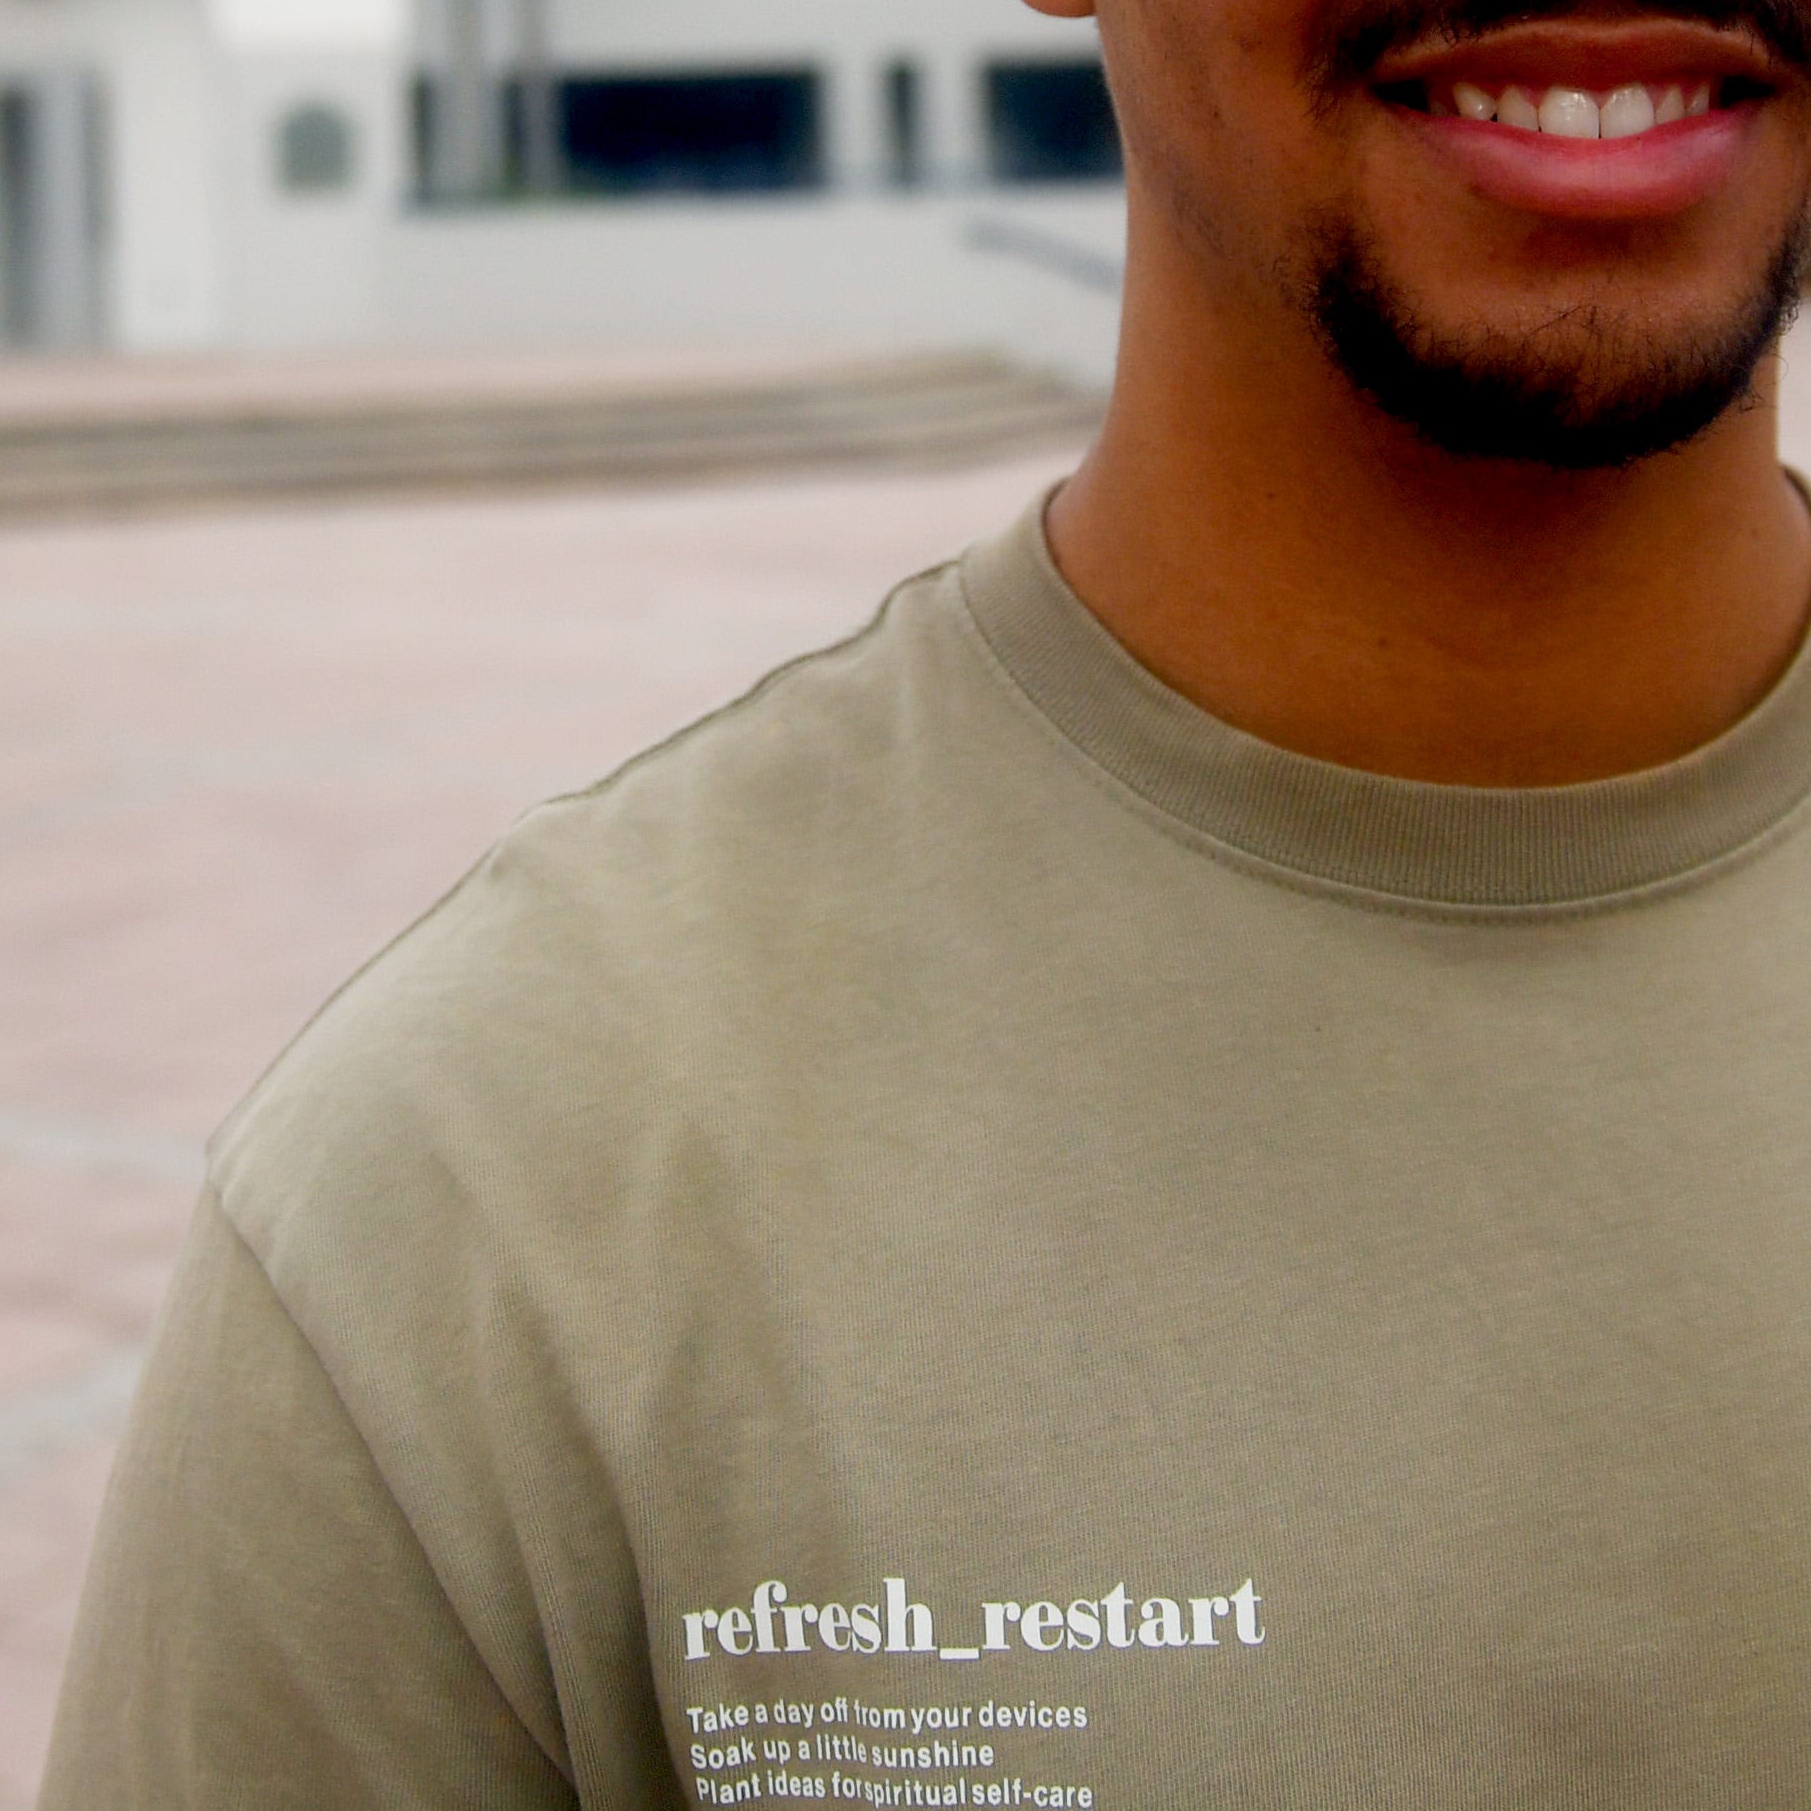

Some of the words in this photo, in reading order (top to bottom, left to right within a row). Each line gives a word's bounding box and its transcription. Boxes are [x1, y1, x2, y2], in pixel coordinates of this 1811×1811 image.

[683, 1578, 1266, 1660] refresh_restart
[686, 1702, 750, 1734] Take
[755, 1702, 769, 1724] a
[773, 1698, 815, 1729] day
[820, 1696, 849, 1723] off
[853, 1699, 906, 1730] from
[910, 1706, 973, 1735] your
[978, 1700, 1088, 1729] devices
[690, 1737, 756, 1770] Soak
[763, 1739, 791, 1765] up
[798, 1739, 811, 1761] a
[816, 1734, 868, 1764] little
[872, 1740, 995, 1769] sunshine
[695, 1772, 762, 1805] Plant
[767, 1769, 827, 1799] ideas
[831, 1770, 862, 1799] for
[865, 1778, 967, 1809] spiritual
[971, 1777, 1093, 1809] self-care
